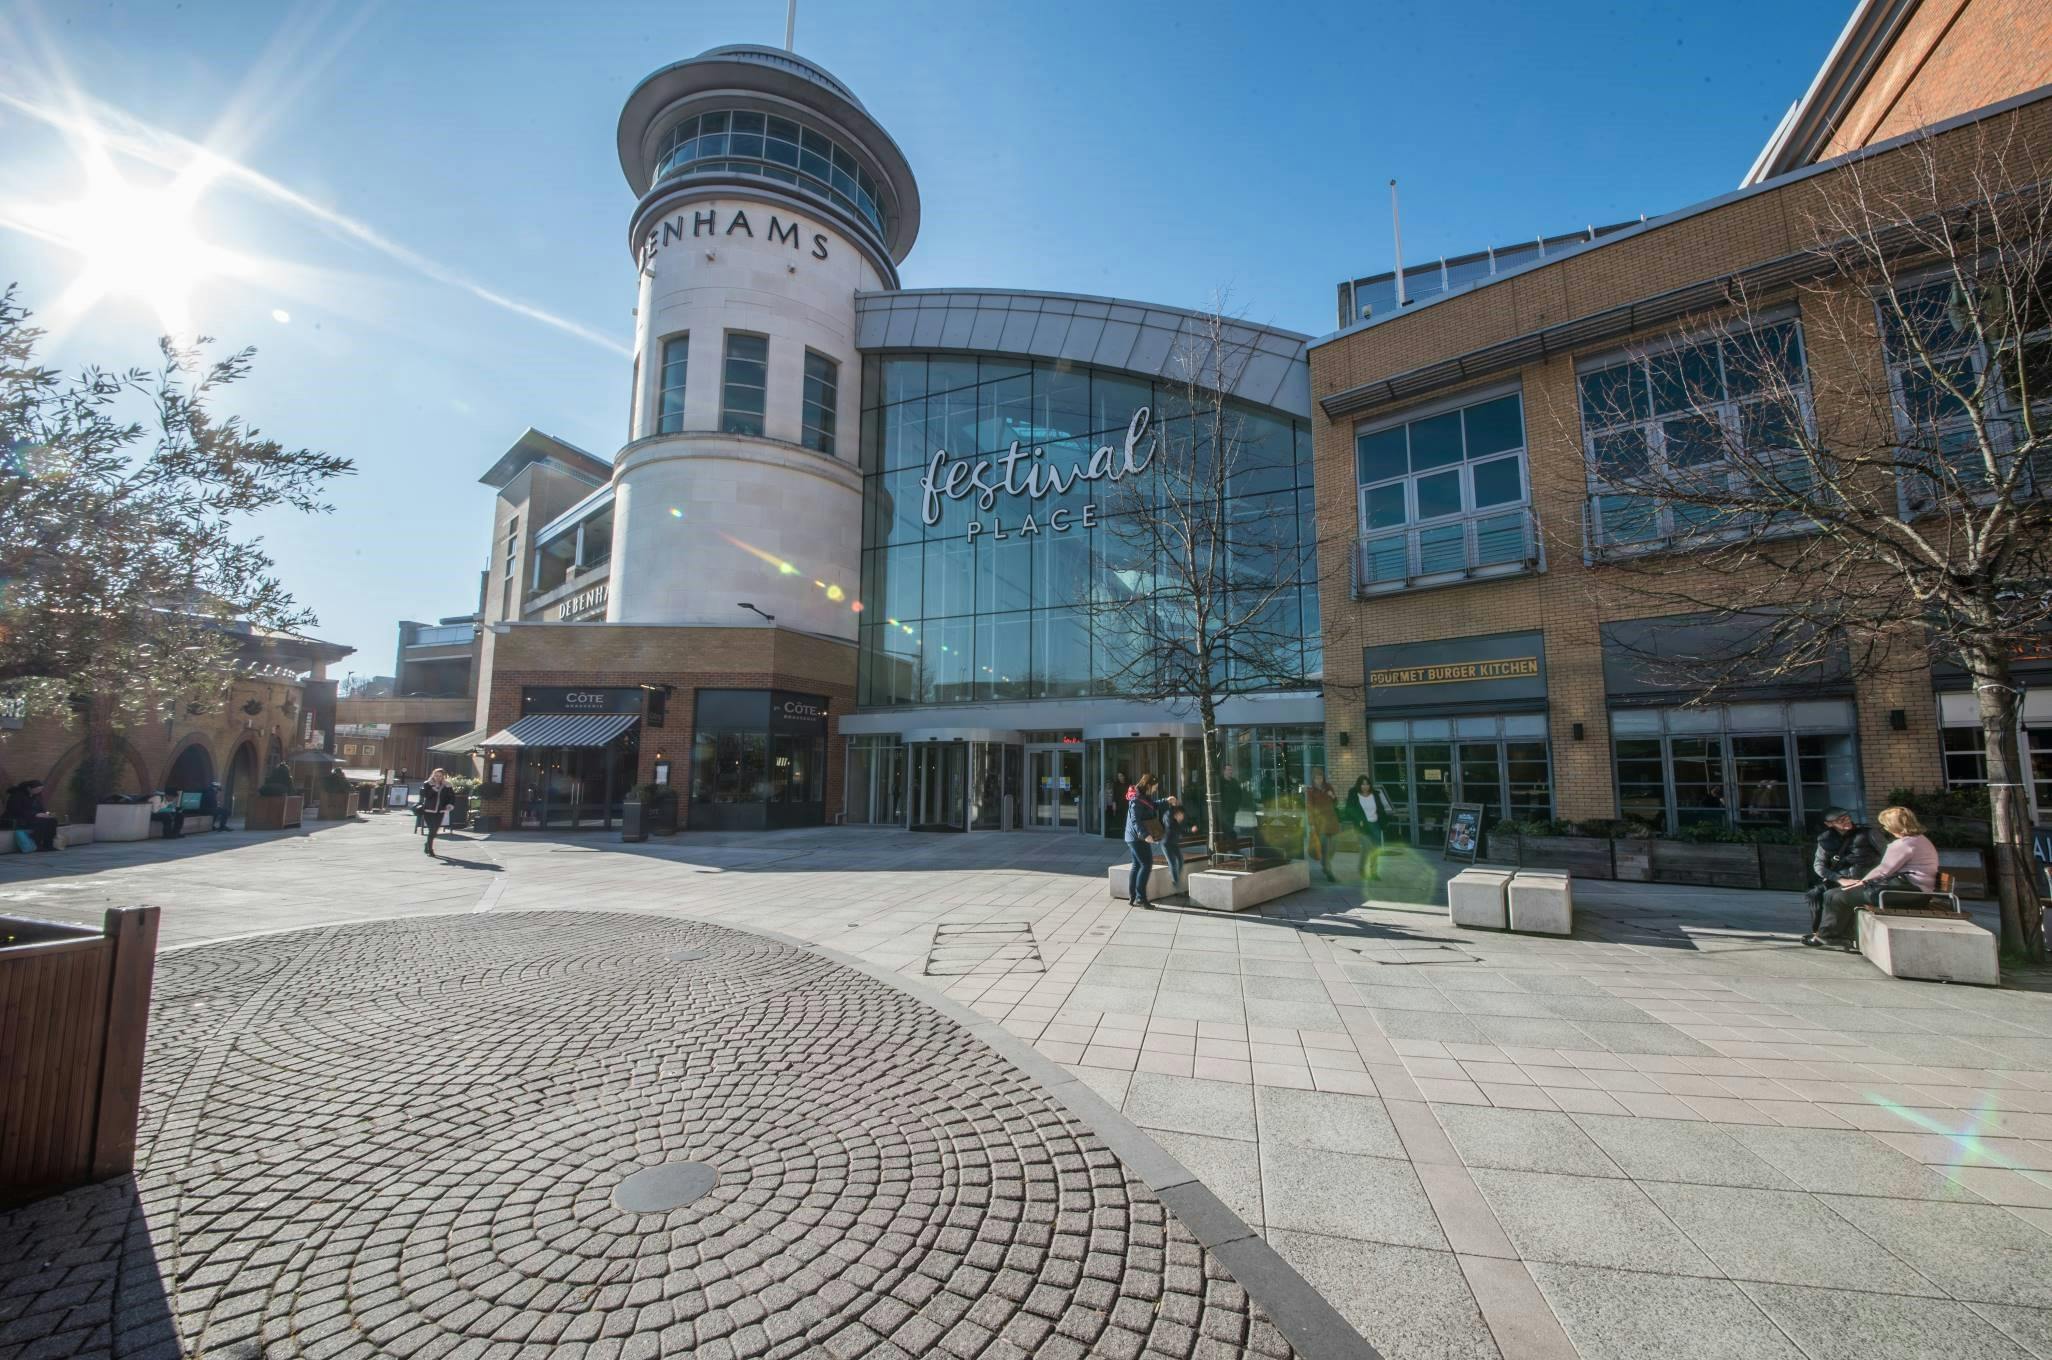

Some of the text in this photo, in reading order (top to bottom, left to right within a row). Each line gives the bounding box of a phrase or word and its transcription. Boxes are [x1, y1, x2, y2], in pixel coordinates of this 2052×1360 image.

[920, 406, 1157, 525] festival
[967, 504, 1097, 543] PLACE
[1370, 660, 1538, 684] GOURMET BURGER KITCHEN
